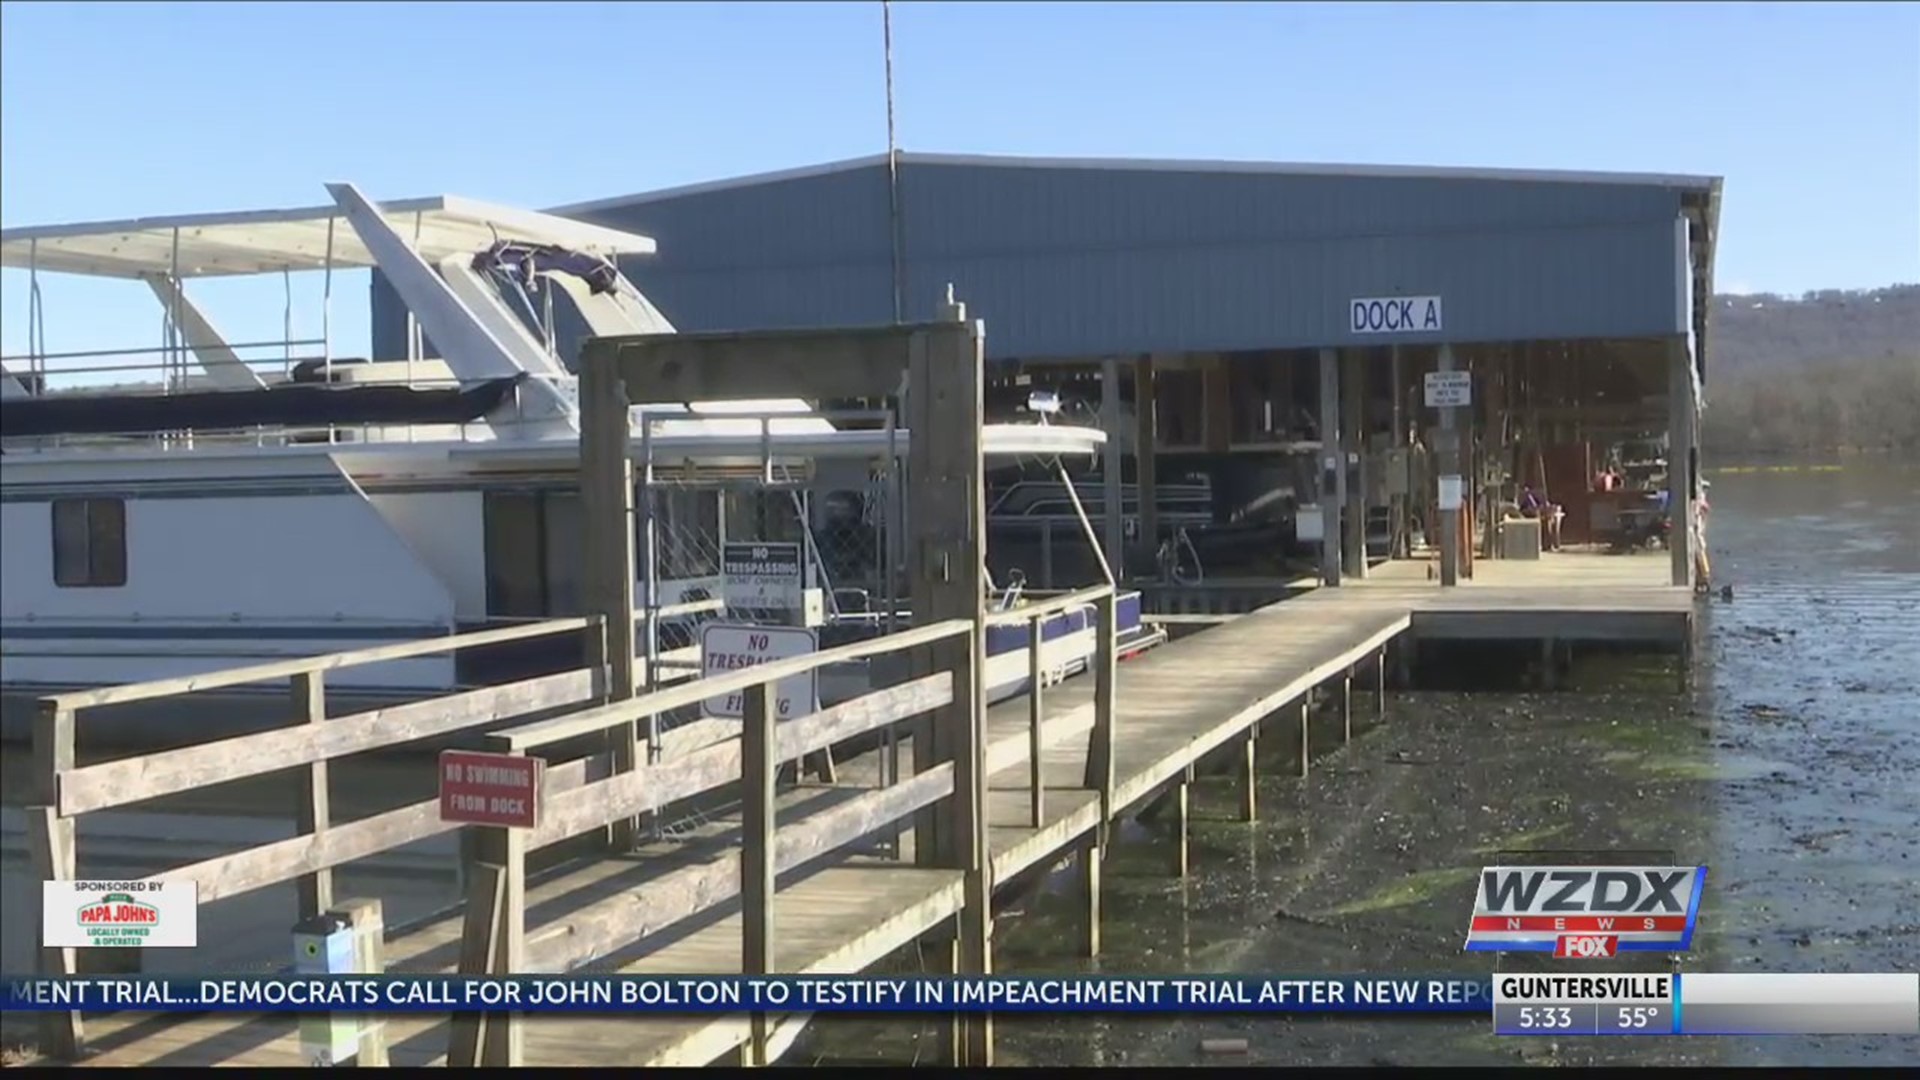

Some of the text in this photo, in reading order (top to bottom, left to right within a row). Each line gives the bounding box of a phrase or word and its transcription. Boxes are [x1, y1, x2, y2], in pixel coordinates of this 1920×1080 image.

[1353, 299, 1438, 331] DOCK A
[752, 547, 769, 559] NO
[726, 562, 797, 574] TRESPASSING
[748, 634, 769, 651] NO
[446, 763, 529, 787] NO SWIMMING
[450, 793, 525, 815] FROM DOCK
